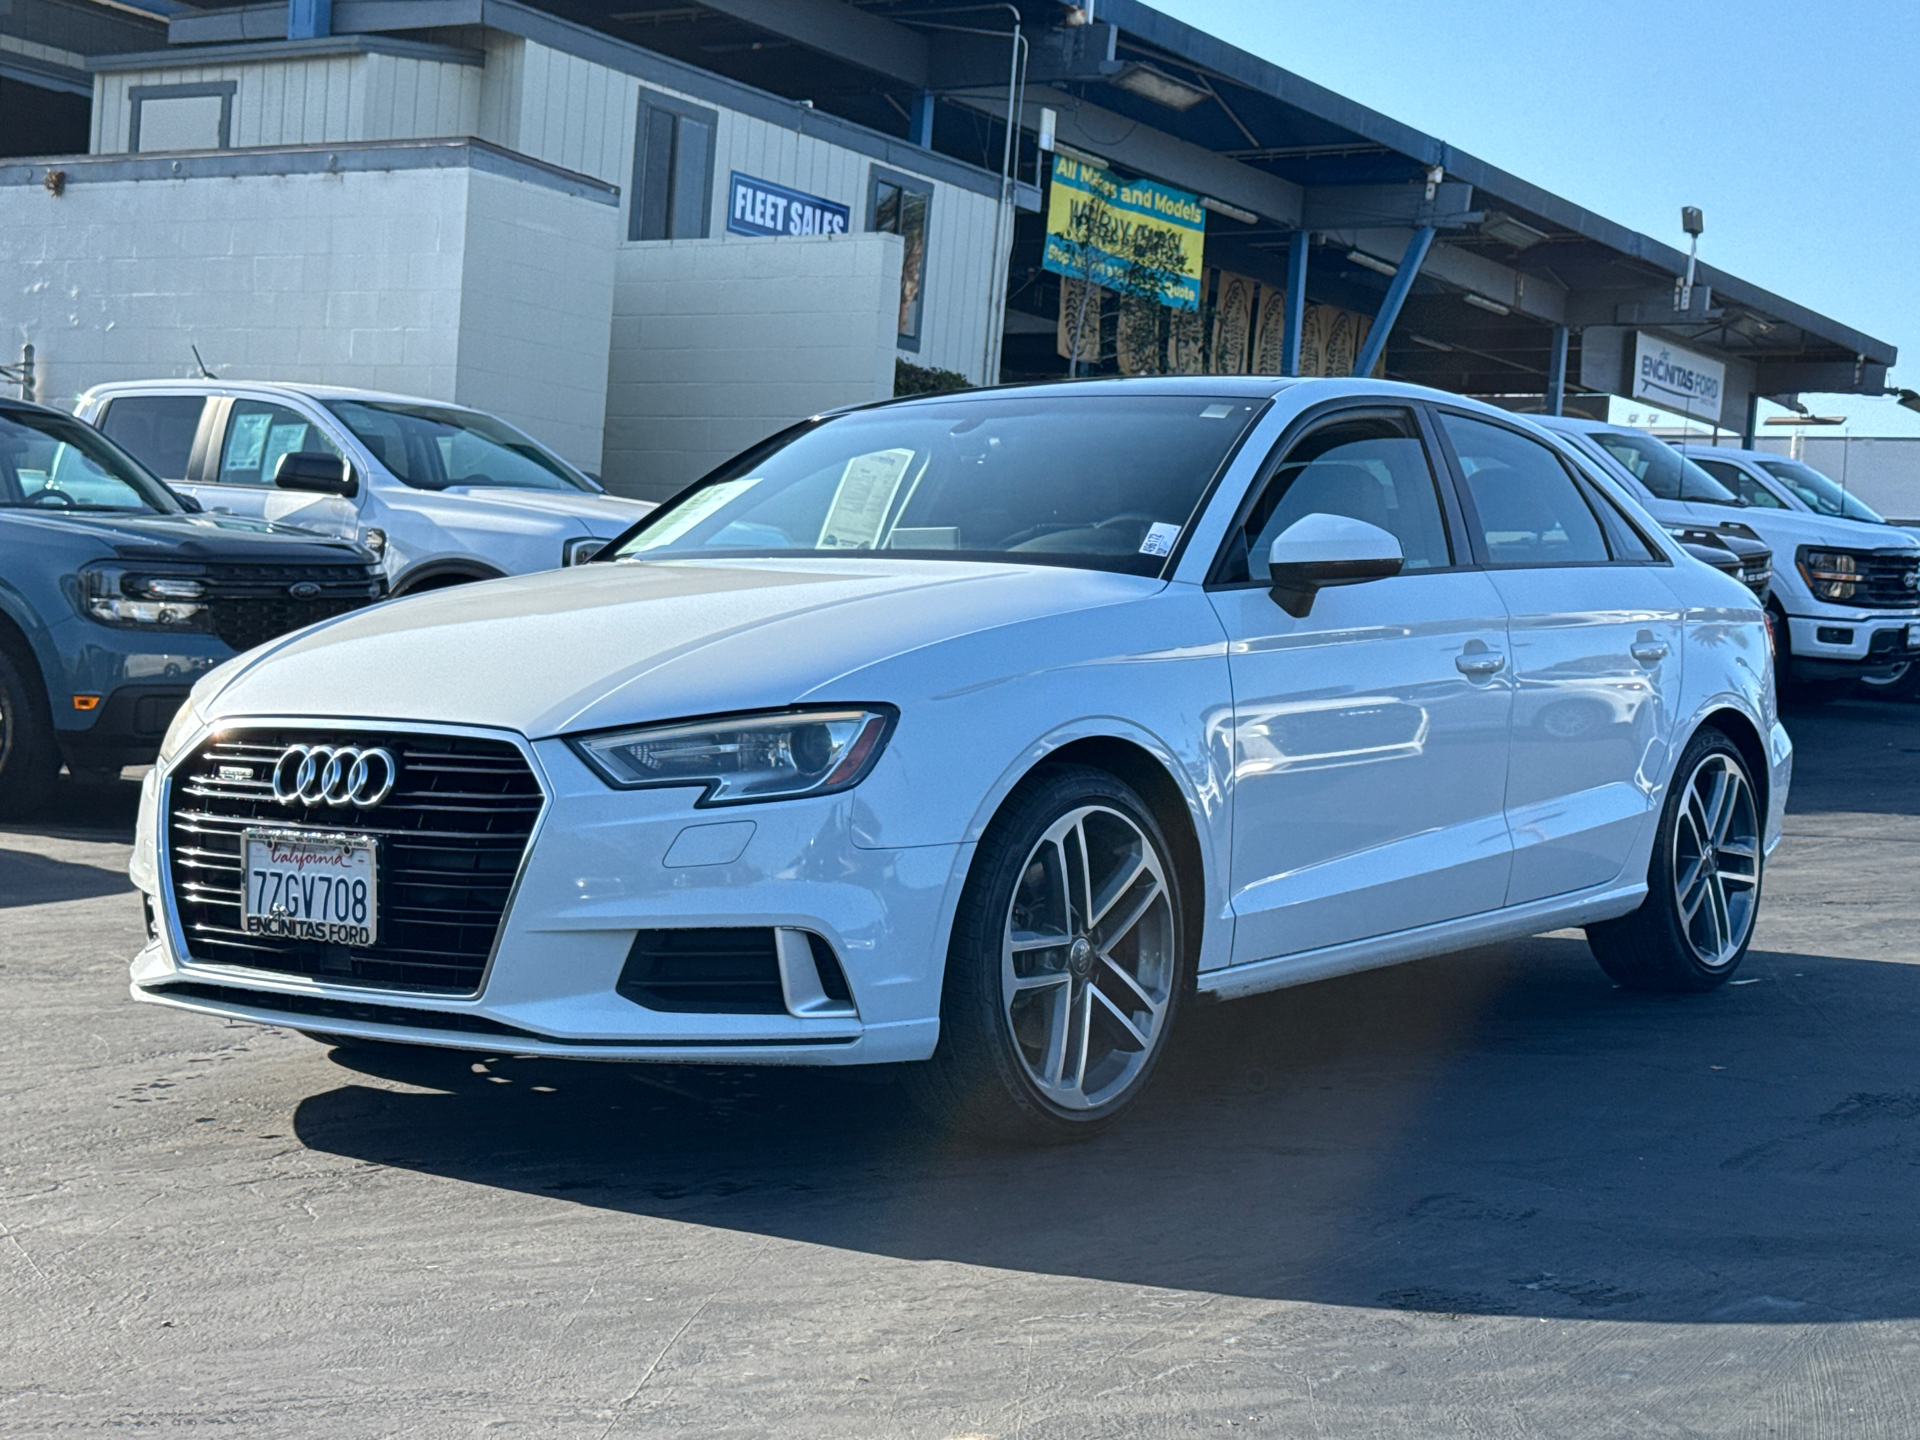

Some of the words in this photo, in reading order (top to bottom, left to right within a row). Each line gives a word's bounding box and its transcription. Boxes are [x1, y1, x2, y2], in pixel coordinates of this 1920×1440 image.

[1056, 157, 1077, 180] All
[1120, 187, 1153, 209] and
[1154, 193, 1202, 223] Models
[734, 184, 788, 232] FLEET
[789, 201, 844, 236] SALES
[1163, 280, 1196, 302] Quote
[1694, 372, 1719, 400] FORD
[271, 842, 353, 871] California
[253, 870, 367, 925] 7ZGV708
[247, 916, 326, 939] ENCINITAS
[329, 923, 370, 945] FORD
